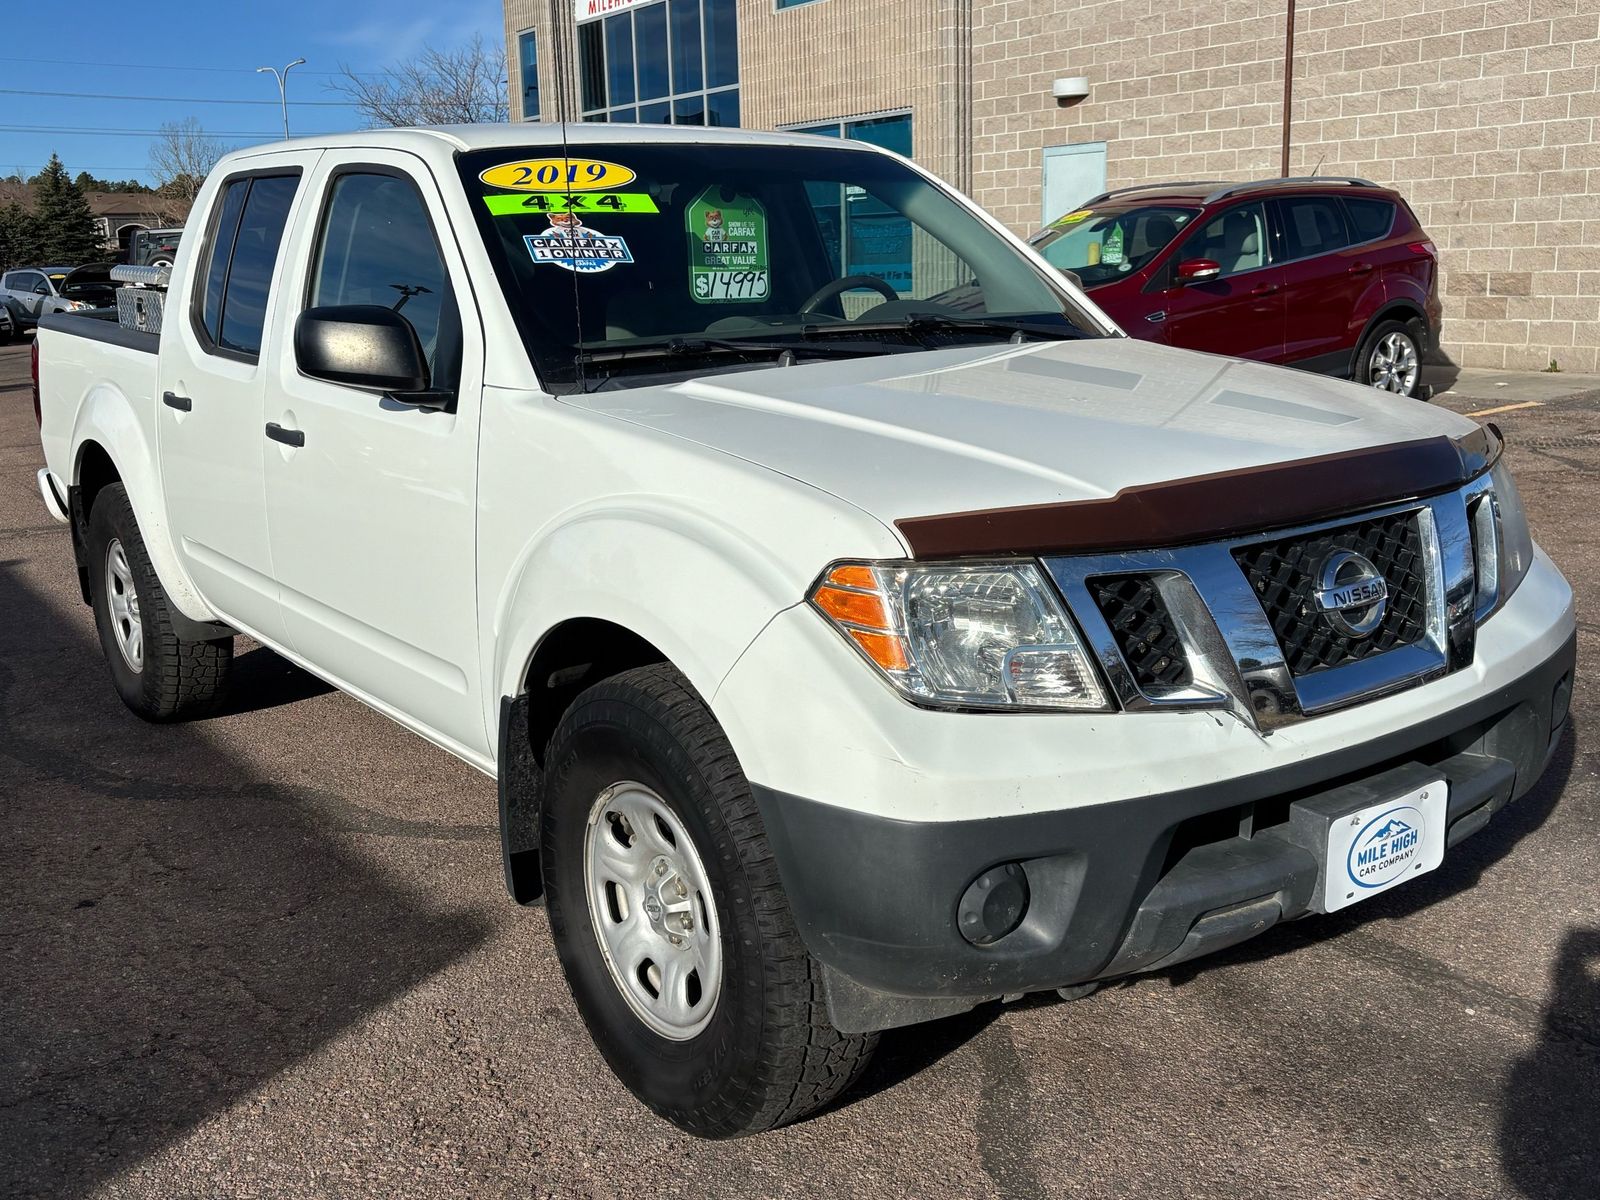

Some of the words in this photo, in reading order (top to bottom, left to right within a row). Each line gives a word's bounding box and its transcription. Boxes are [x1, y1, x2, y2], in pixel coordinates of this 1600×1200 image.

[588, 0, 637, 15] MILEH
[511, 163, 607, 185] 2019
[728, 227, 756, 236] CARFAX
[533, 239, 619, 249] CARFAX
[704, 242, 757, 254] CARFAX
[538, 249, 549, 258] 1
[553, 249, 624, 258] OWNER
[704, 255, 731, 265] GREAT
[731, 255, 757, 265] VALUE
[1333, 580, 1386, 606] NISSAN
[1357, 843, 1388, 867] MILE
[1391, 829, 1418, 855] HIGH
[1359, 864, 1377, 878] CAR
[1378, 848, 1415, 870] COMPANY
